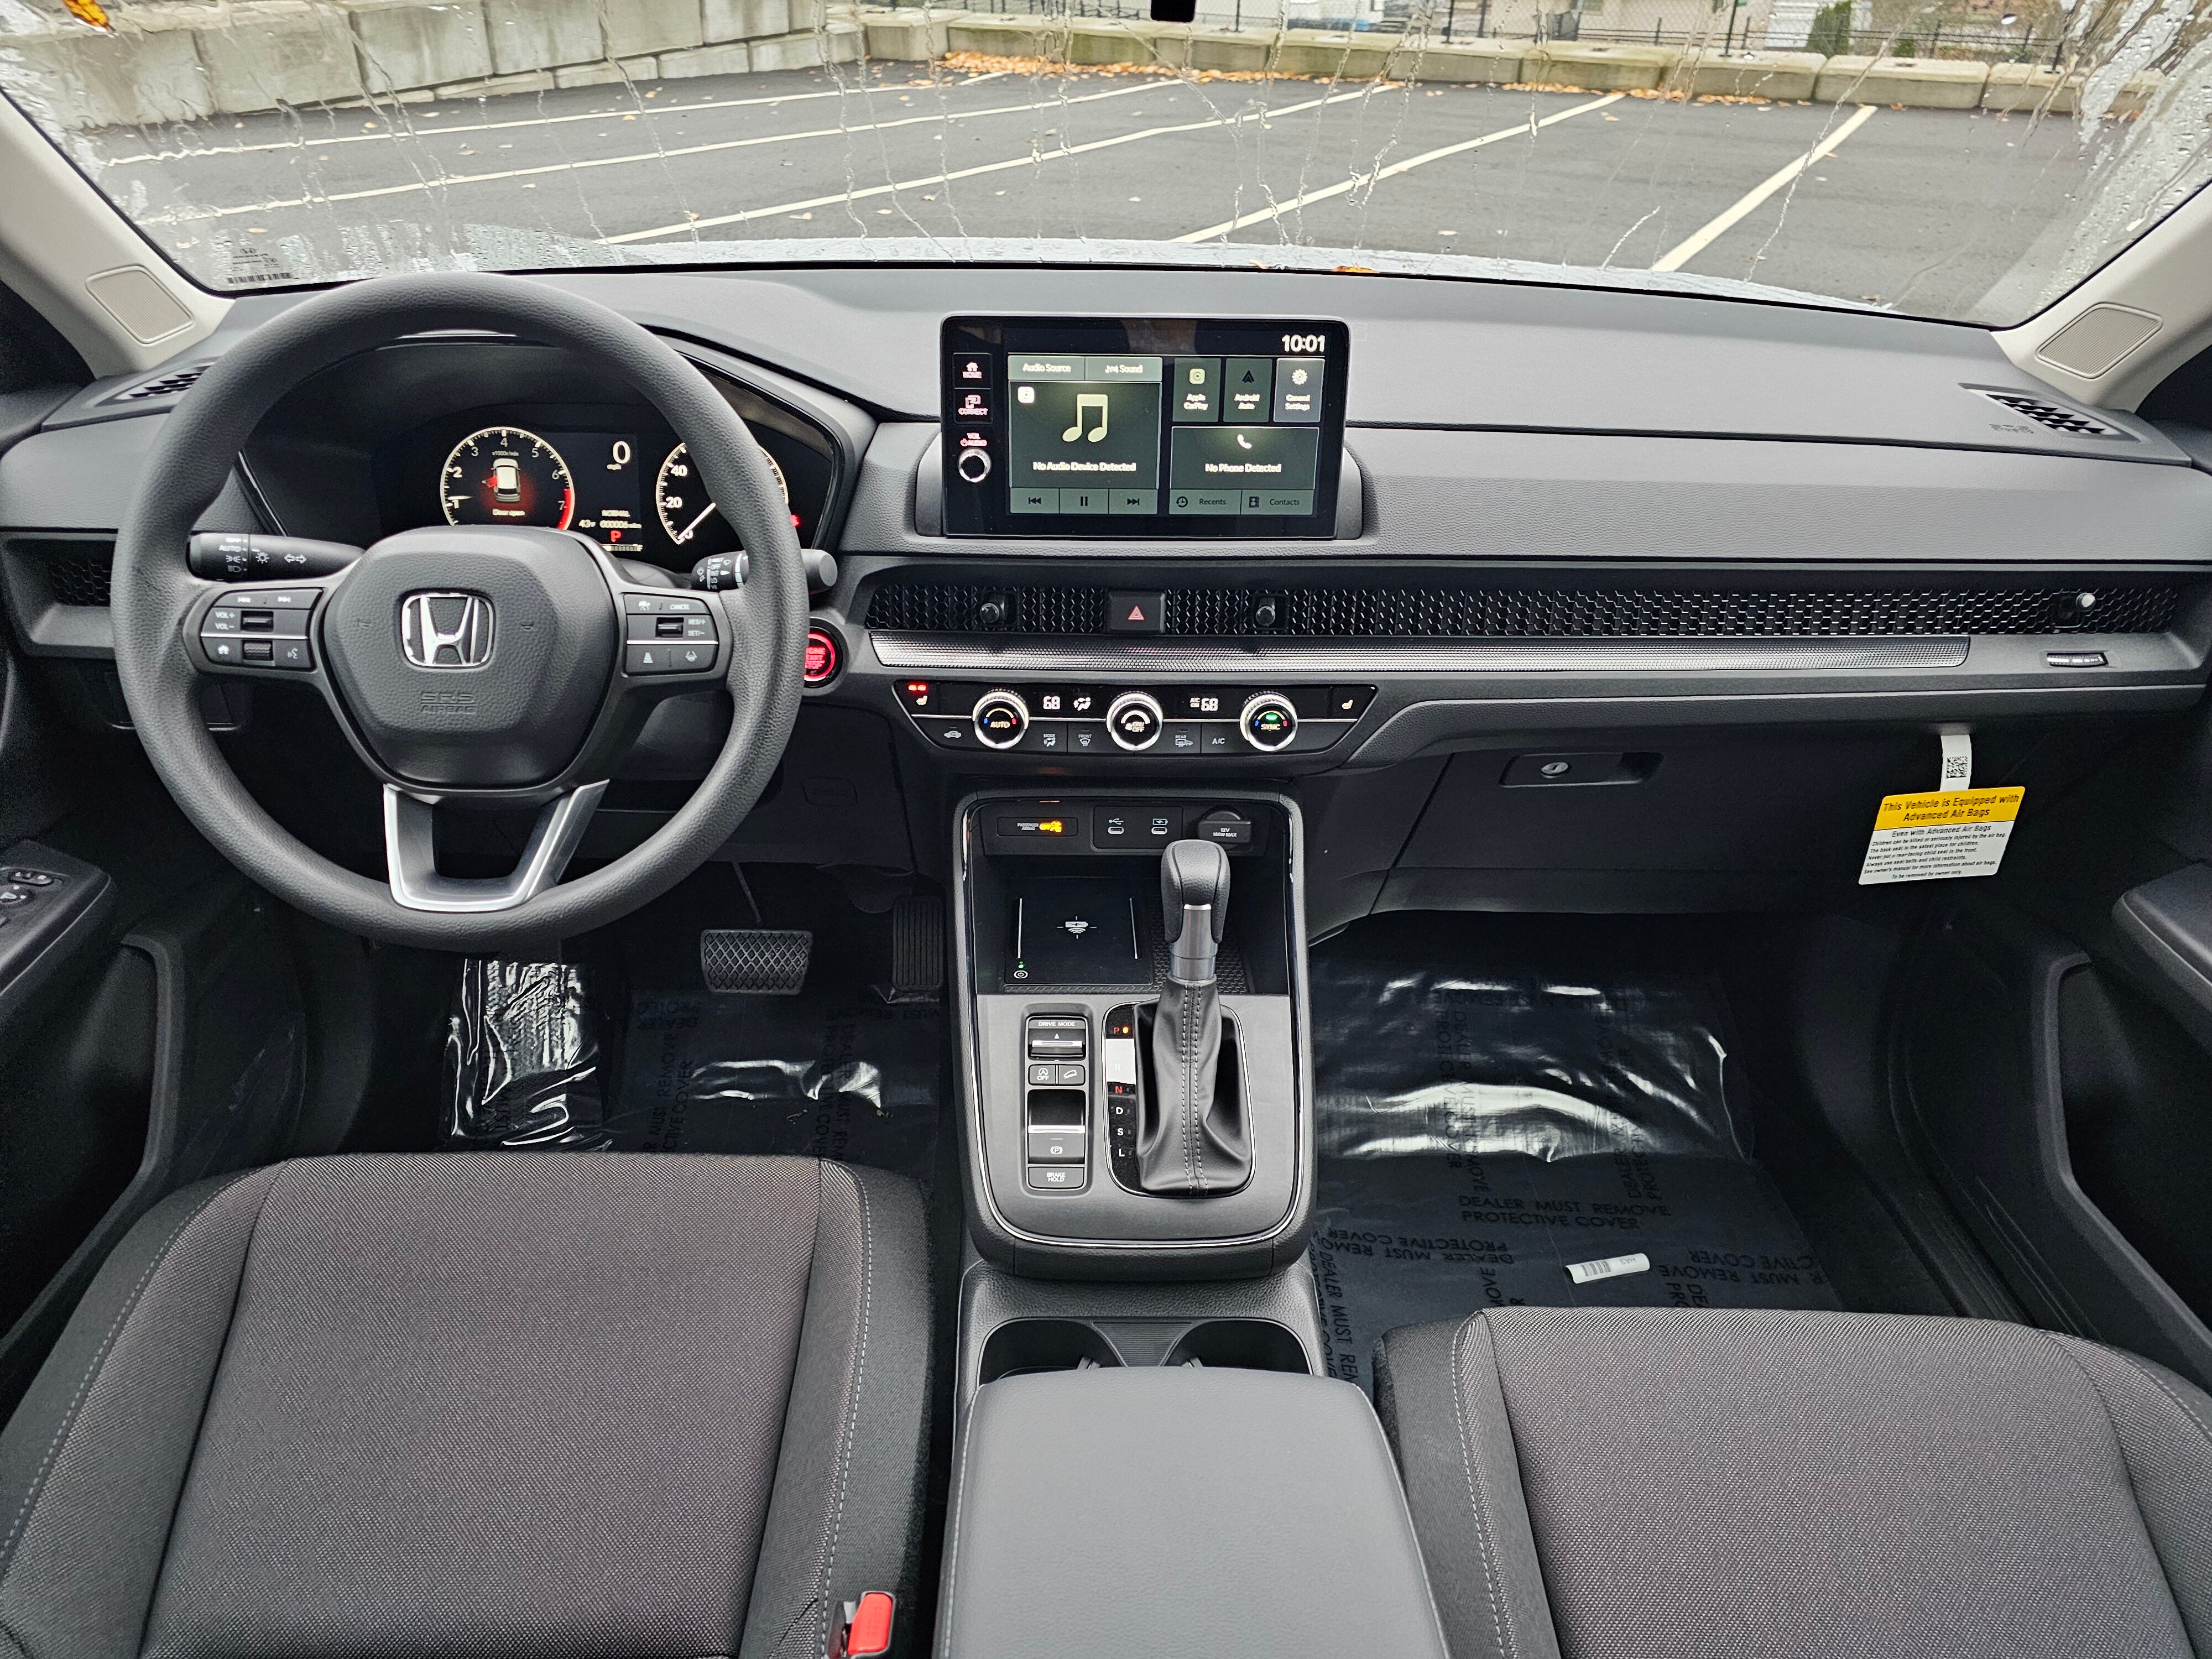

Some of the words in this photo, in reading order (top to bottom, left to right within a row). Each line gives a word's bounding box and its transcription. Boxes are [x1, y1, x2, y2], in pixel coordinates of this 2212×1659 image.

[1282, 335, 1325, 352] 10:01
[1022, 363, 1045, 372] Audio
[1046, 364, 1071, 372] Source
[1118, 364, 1142, 373] Sound
[500, 437, 508, 447] 4
[471, 447, 478, 456] 3
[531, 448, 539, 457] 5
[612, 441, 630, 463] 0
[453, 466, 462, 478] 2
[671, 465, 688, 476] 40
[1032, 462, 1046, 470] No
[1046, 462, 1071, 470] Audio
[1071, 462, 1099, 471] Device
[1099, 462, 1136, 471] Detected
[1205, 463, 1218, 472] No
[1218, 463, 1244, 472] Phone
[1245, 463, 1282, 472] Detected
[551, 470, 560, 479] 6
[558, 500, 565, 510] 7
[666, 497, 682, 508] 20
[611, 530, 622, 542] P
[421, 692, 474, 703] SRS
[1043, 696, 1060, 709] 68
[420, 706, 476, 714] AIRBAG
[1201, 698, 1218, 711] 68
[1884, 802, 1902, 812] This
[1906, 799, 1939, 809] Vehicle
[1942, 799, 1950, 807] is
[1953, 795, 1997, 807] Equipped
[2000, 794, 2019, 803] with
[1903, 810, 1949, 821] Advanced
[1950, 810, 1965, 818] Air
[1967, 808, 1990, 817] Bags
[1118, 1149, 1125, 1157] L
[1458, 1195, 1524, 1210] DEALER
[1536, 1199, 1580, 1213] MUST
[1592, 1202, 1671, 1217] REMOVE
[1461, 1211, 1569, 1227] PROTECTIVE
[1575, 1217, 1640, 1229] COVER
[1327, 1227, 1392, 1244] COVER
[1321, 1237, 1373, 1256] REMO
[1397, 1236, 1507, 1253] PROTECTIVE
[1385, 1247, 1431, 1260] MUST
[1442, 1252, 1514, 1264] DEALER
[1331, 1305, 1353, 1344] MUST
